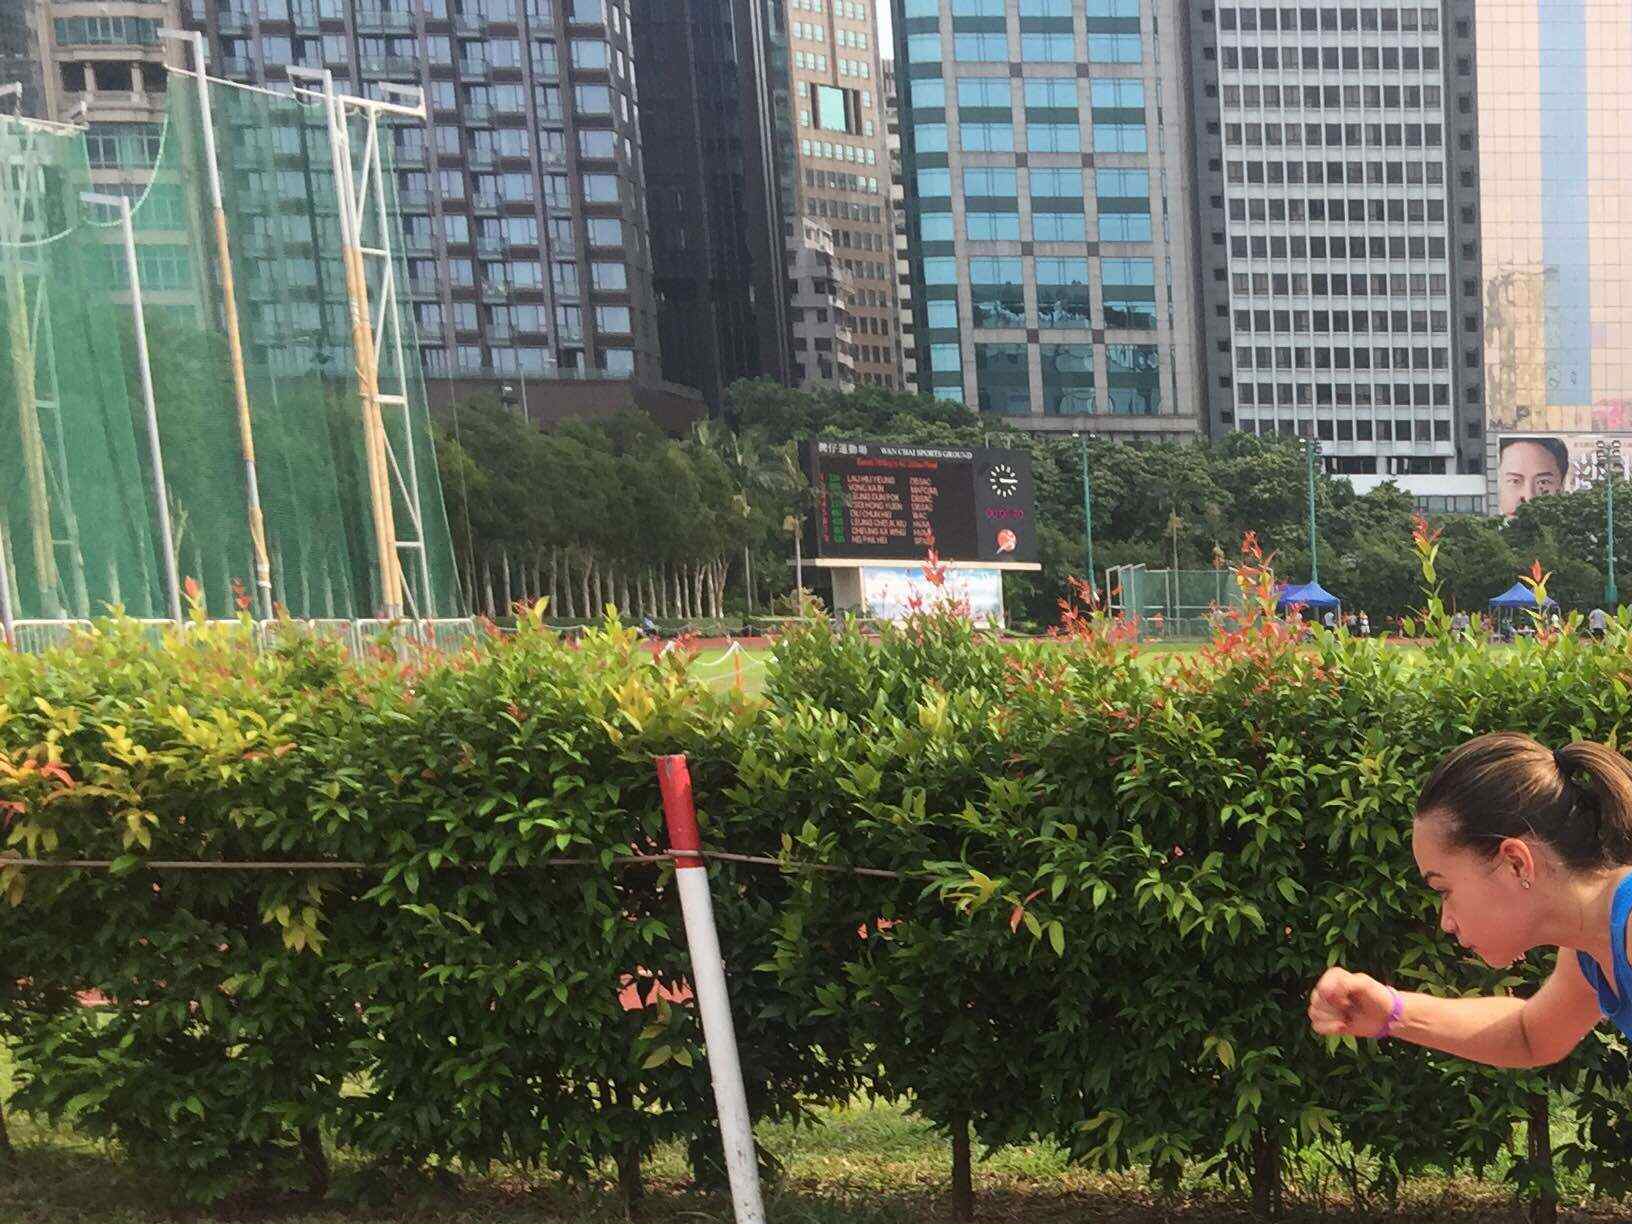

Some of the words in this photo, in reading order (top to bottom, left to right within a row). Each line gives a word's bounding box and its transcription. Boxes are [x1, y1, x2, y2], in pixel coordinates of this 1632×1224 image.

[879, 446, 897, 455] WAN
[897, 447, 916, 457] CHAI
[916, 448, 943, 458] SPORTS
[942, 449, 973, 460] GROUND
